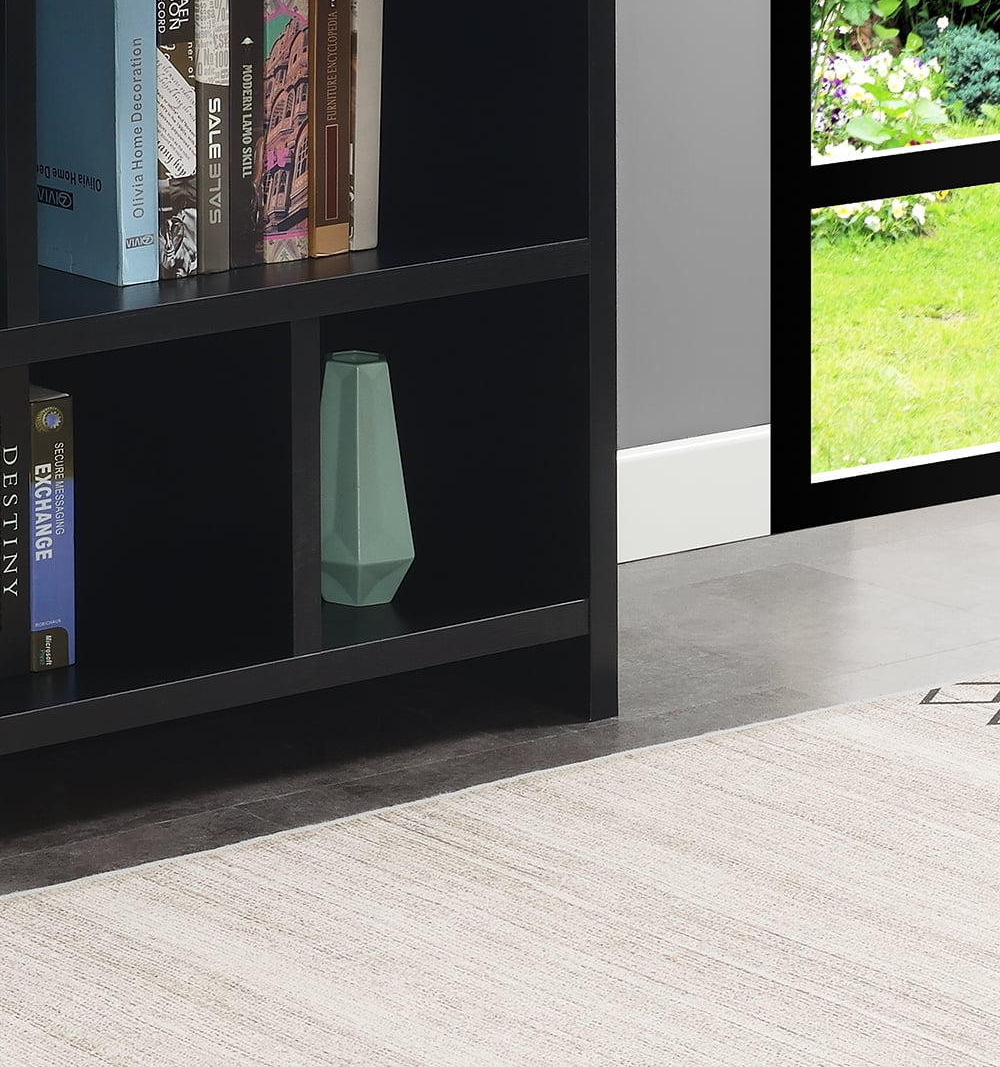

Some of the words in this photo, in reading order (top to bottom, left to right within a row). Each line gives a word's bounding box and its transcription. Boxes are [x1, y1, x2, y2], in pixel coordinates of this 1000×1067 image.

[327, 11, 338, 73] ENCYCLOPEDIA
[130, 37, 143, 123] Decoration
[242, 64, 253, 112] MODERN
[326, 74, 338, 122] FURNITURE
[131, 126, 144, 171] Home
[208, 97, 222, 160] SALE
[53, 166, 77, 185] Home
[79, 174, 102, 192] Olivia
[242, 146, 253, 179] SKILL
[131, 174, 145, 219] Olivia
[54, 442, 65, 480] SECURE
[2, 445, 19, 597] DESTINY
[34, 462, 53, 562] EXCHANGE
[54, 480, 66, 536] MESSAGING
[45, 635, 53, 666] Microsoft
